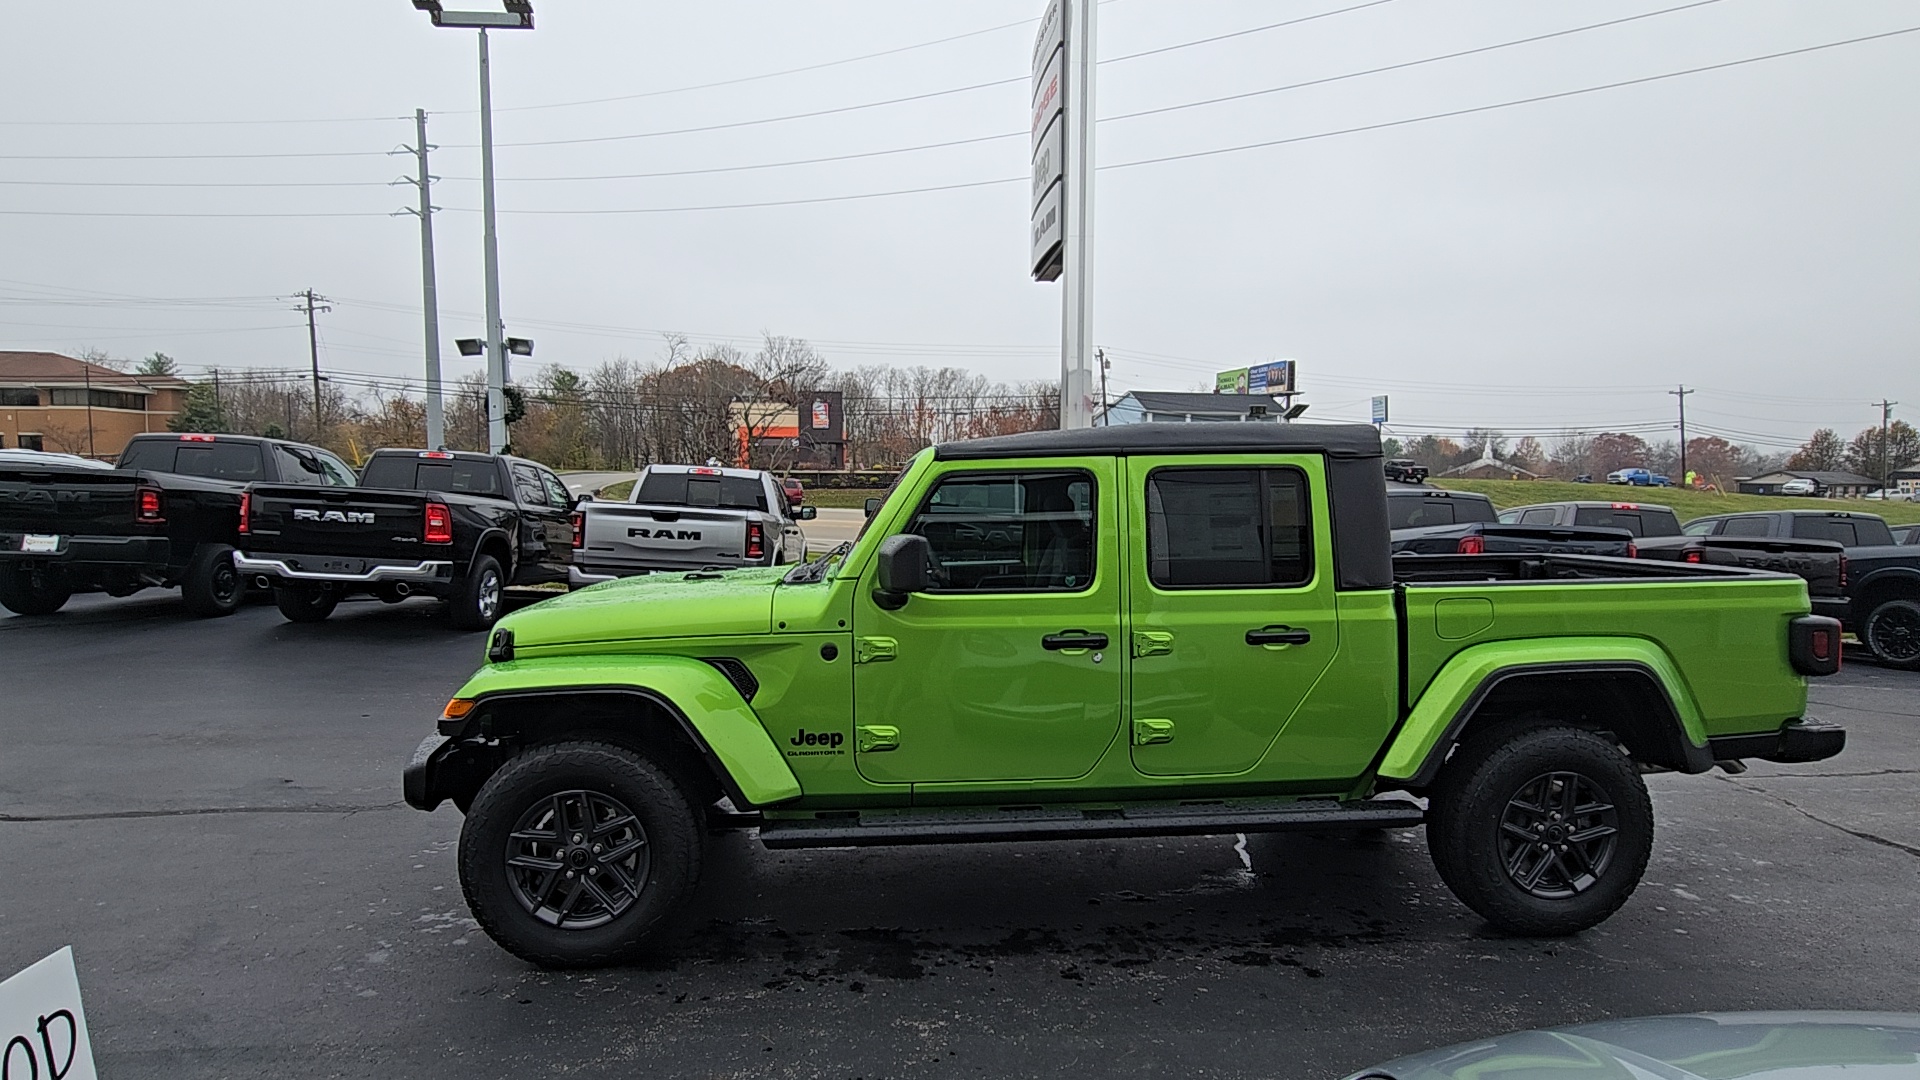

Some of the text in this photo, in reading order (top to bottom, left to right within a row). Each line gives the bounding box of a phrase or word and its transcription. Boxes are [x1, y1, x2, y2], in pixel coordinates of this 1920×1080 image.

[0, 489, 91, 503] RAM
[293, 508, 376, 524] RAM
[627, 527, 702, 541] RAM
[790, 728, 844, 749] Jeep
